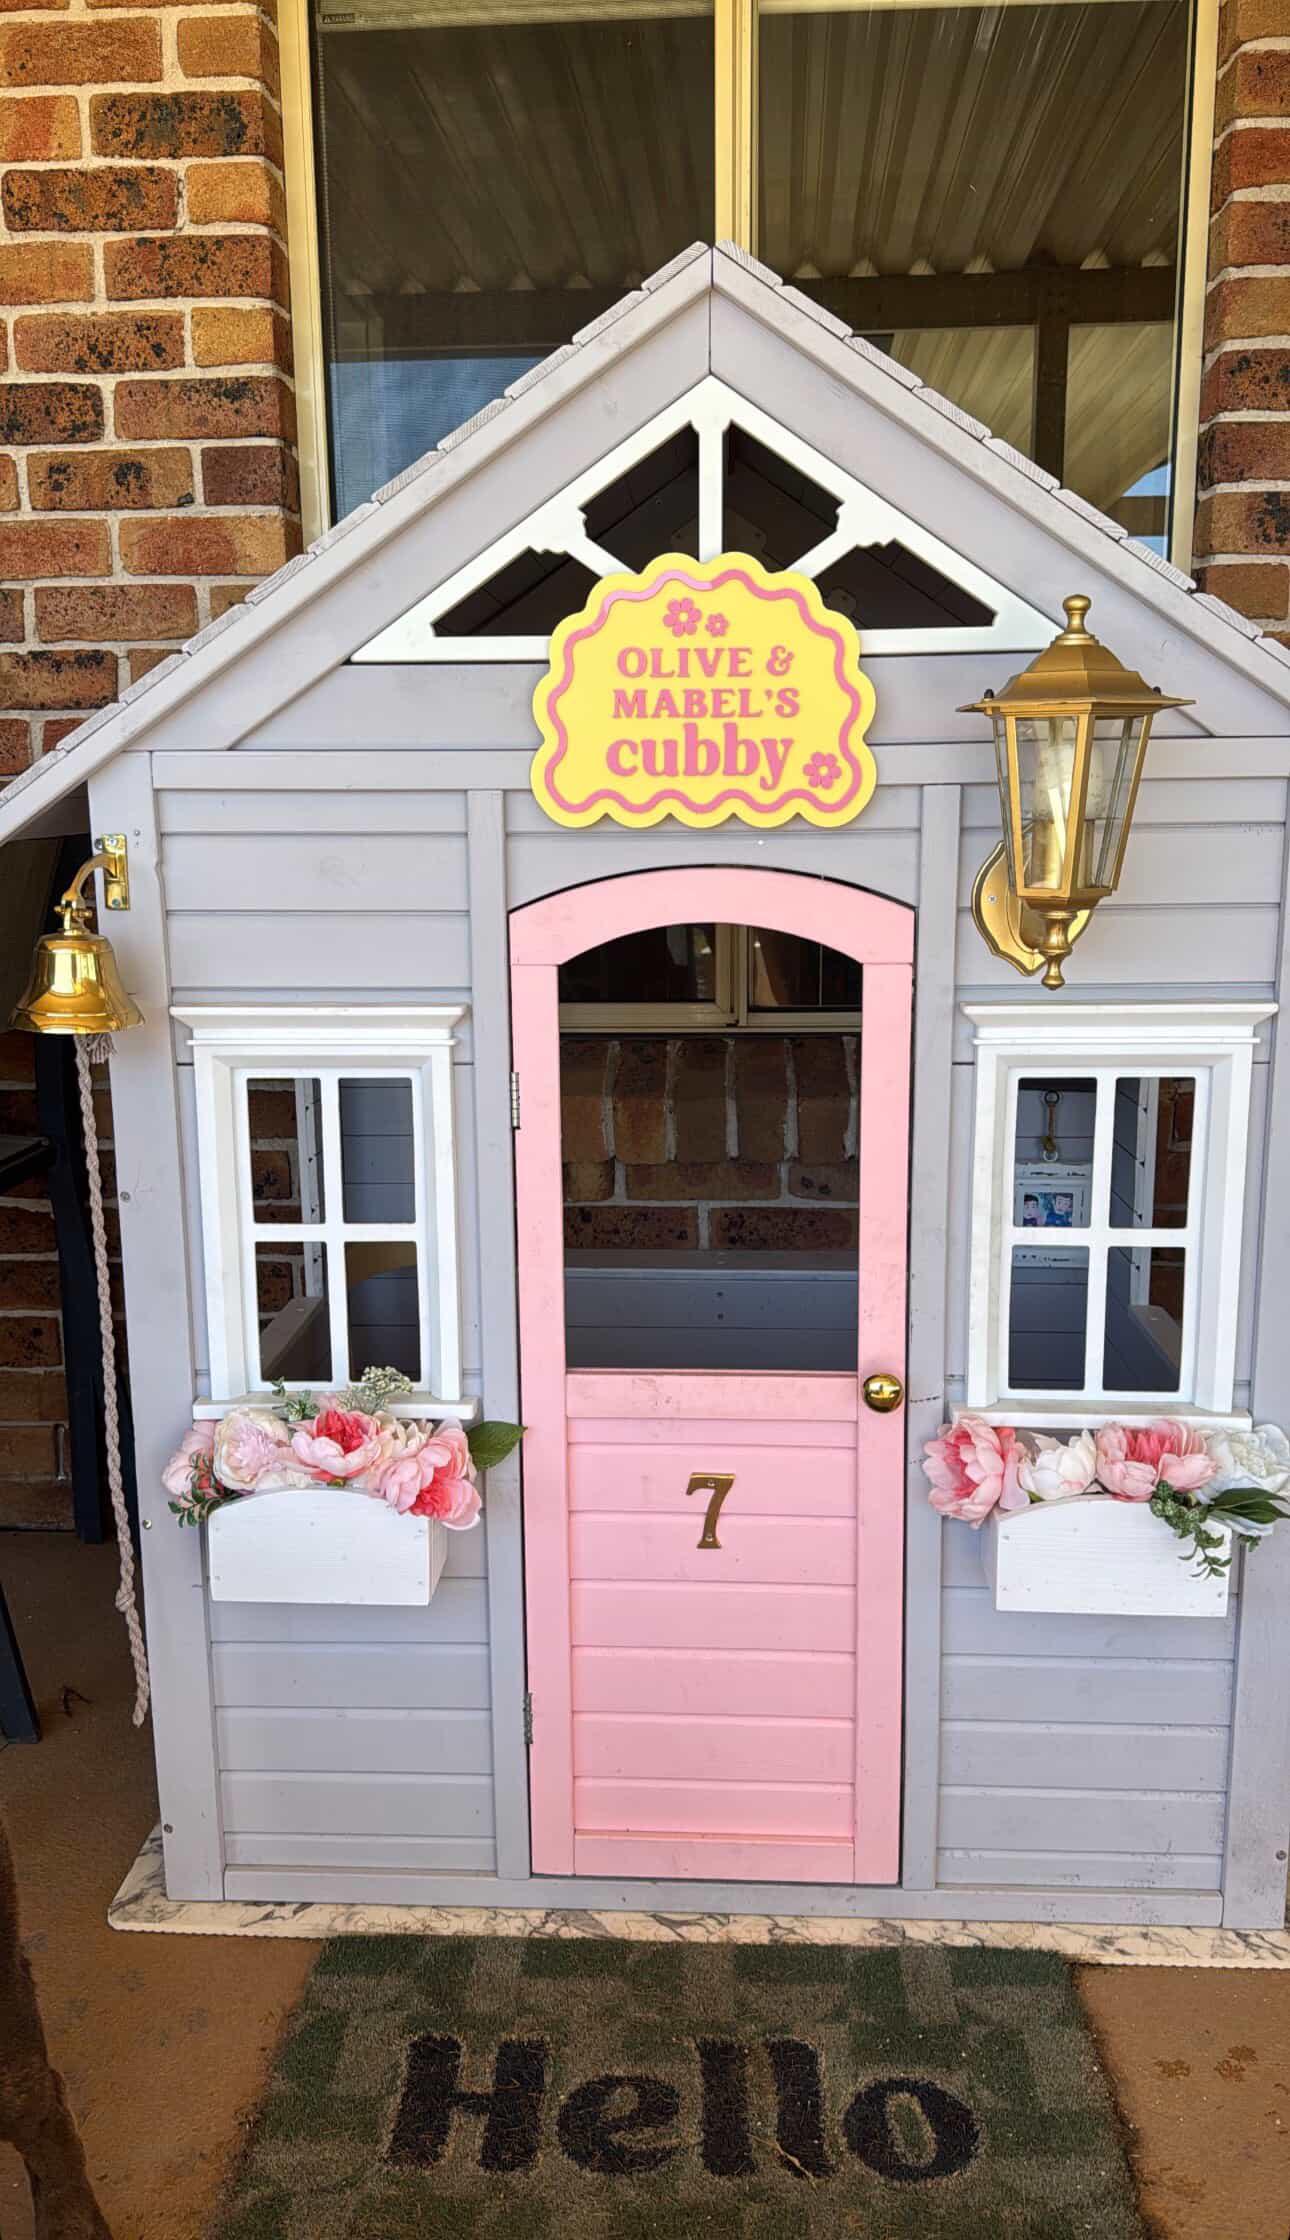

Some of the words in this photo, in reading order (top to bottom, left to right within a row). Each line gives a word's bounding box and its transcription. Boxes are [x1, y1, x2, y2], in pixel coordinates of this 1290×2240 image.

[616, 647, 753, 678] OLIVE
[765, 645, 795, 677] &
[612, 688, 801, 719] MABEL'S
[605, 722, 795, 791] cubby
[686, 1472, 736, 1549] 7
[386, 2033, 982, 2183] Hello
